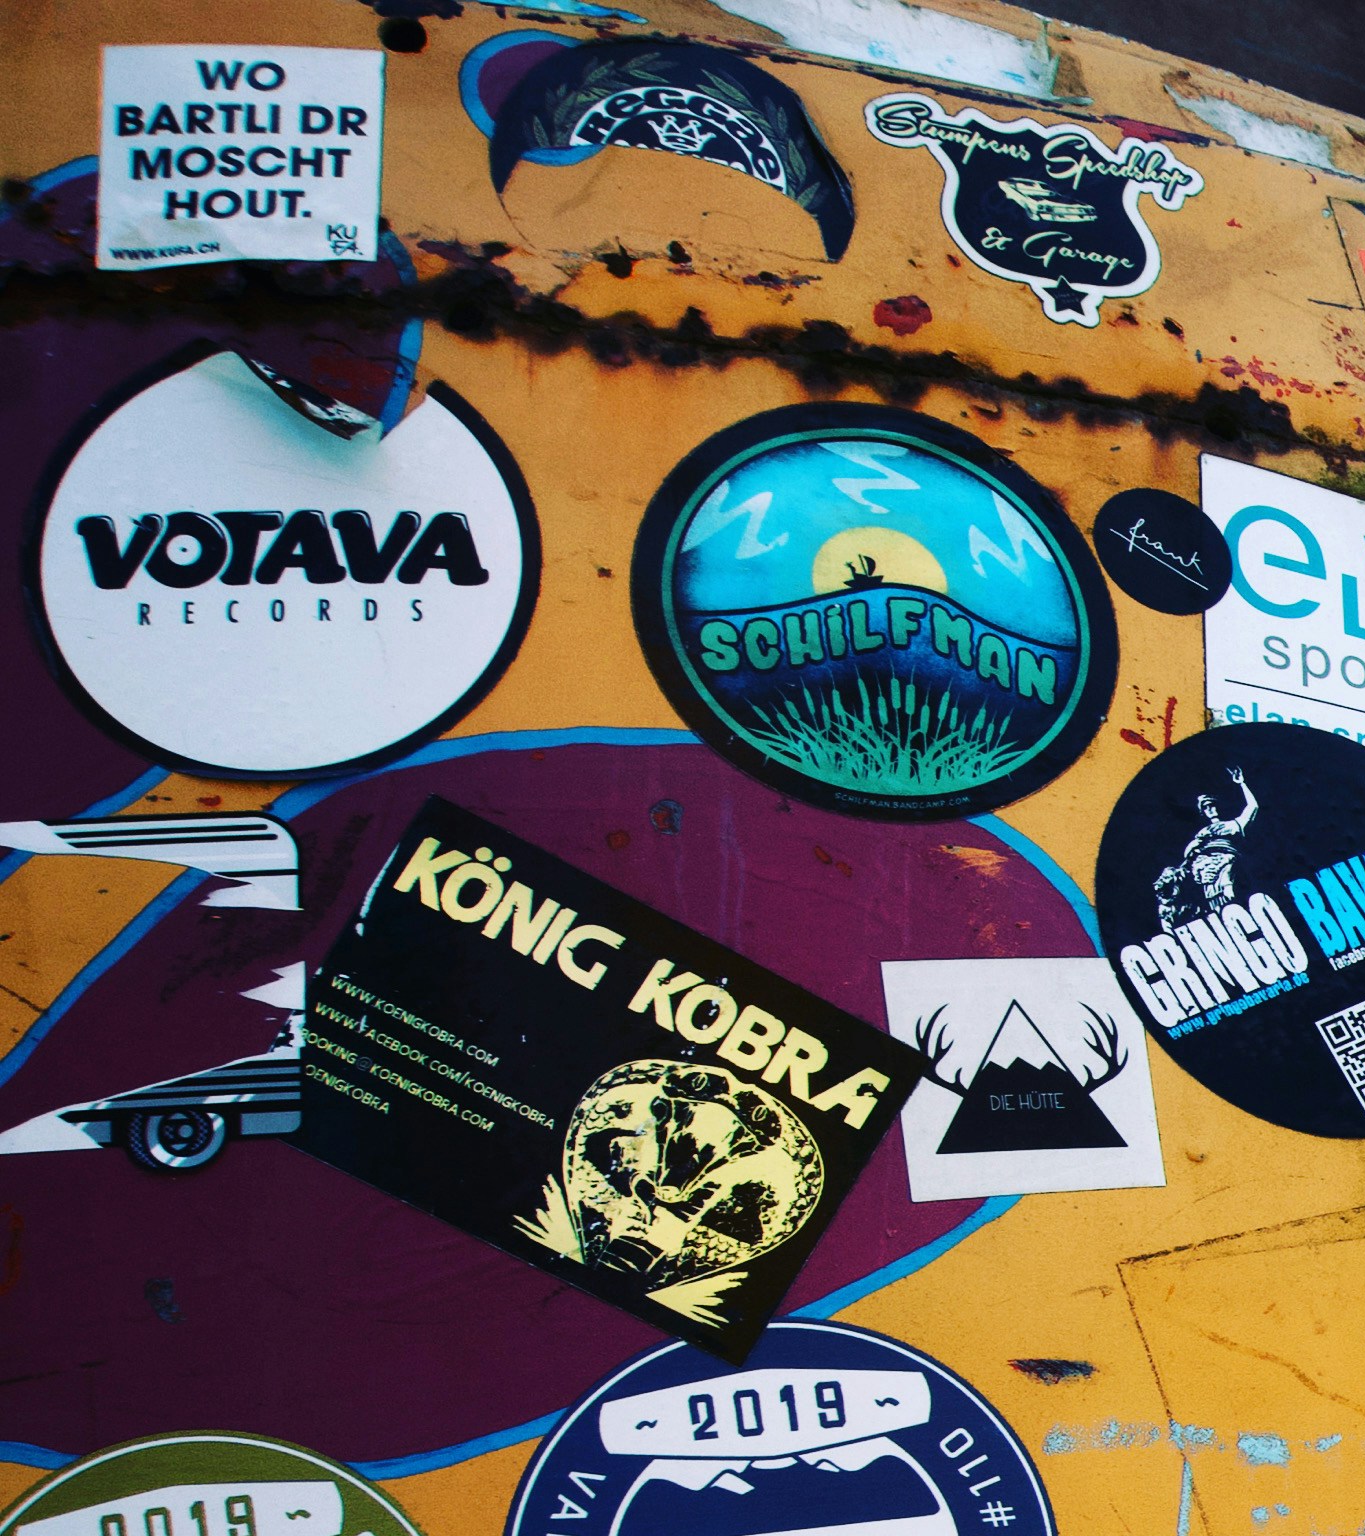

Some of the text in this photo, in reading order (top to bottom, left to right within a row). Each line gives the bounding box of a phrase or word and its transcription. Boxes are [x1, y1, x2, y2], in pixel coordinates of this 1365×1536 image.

[197, 59, 286, 92] WO
[116, 104, 367, 137] BARTLI DR
[131, 145, 351, 181] MOSCHT
[1042, 134, 1194, 201] Speedshop
[164, 188, 312, 221] HOUT.
[981, 226, 1135, 280] & Garage
[76, 509, 489, 590] VOTAVA
[137, 598, 424, 626] RECORDS
[394, 835, 891, 1130] KÖNIG KOBRA
[1119, 892, 1310, 1029] GRINGO
[331, 975, 500, 1068] WWW.KOENIGKOBRA.COM
[1167, 969, 1311, 1040] www.gringobavaria.de
[990, 1090, 1066, 1112] DIE HÜTTE
[690, 1380, 847, 1442] 2019
